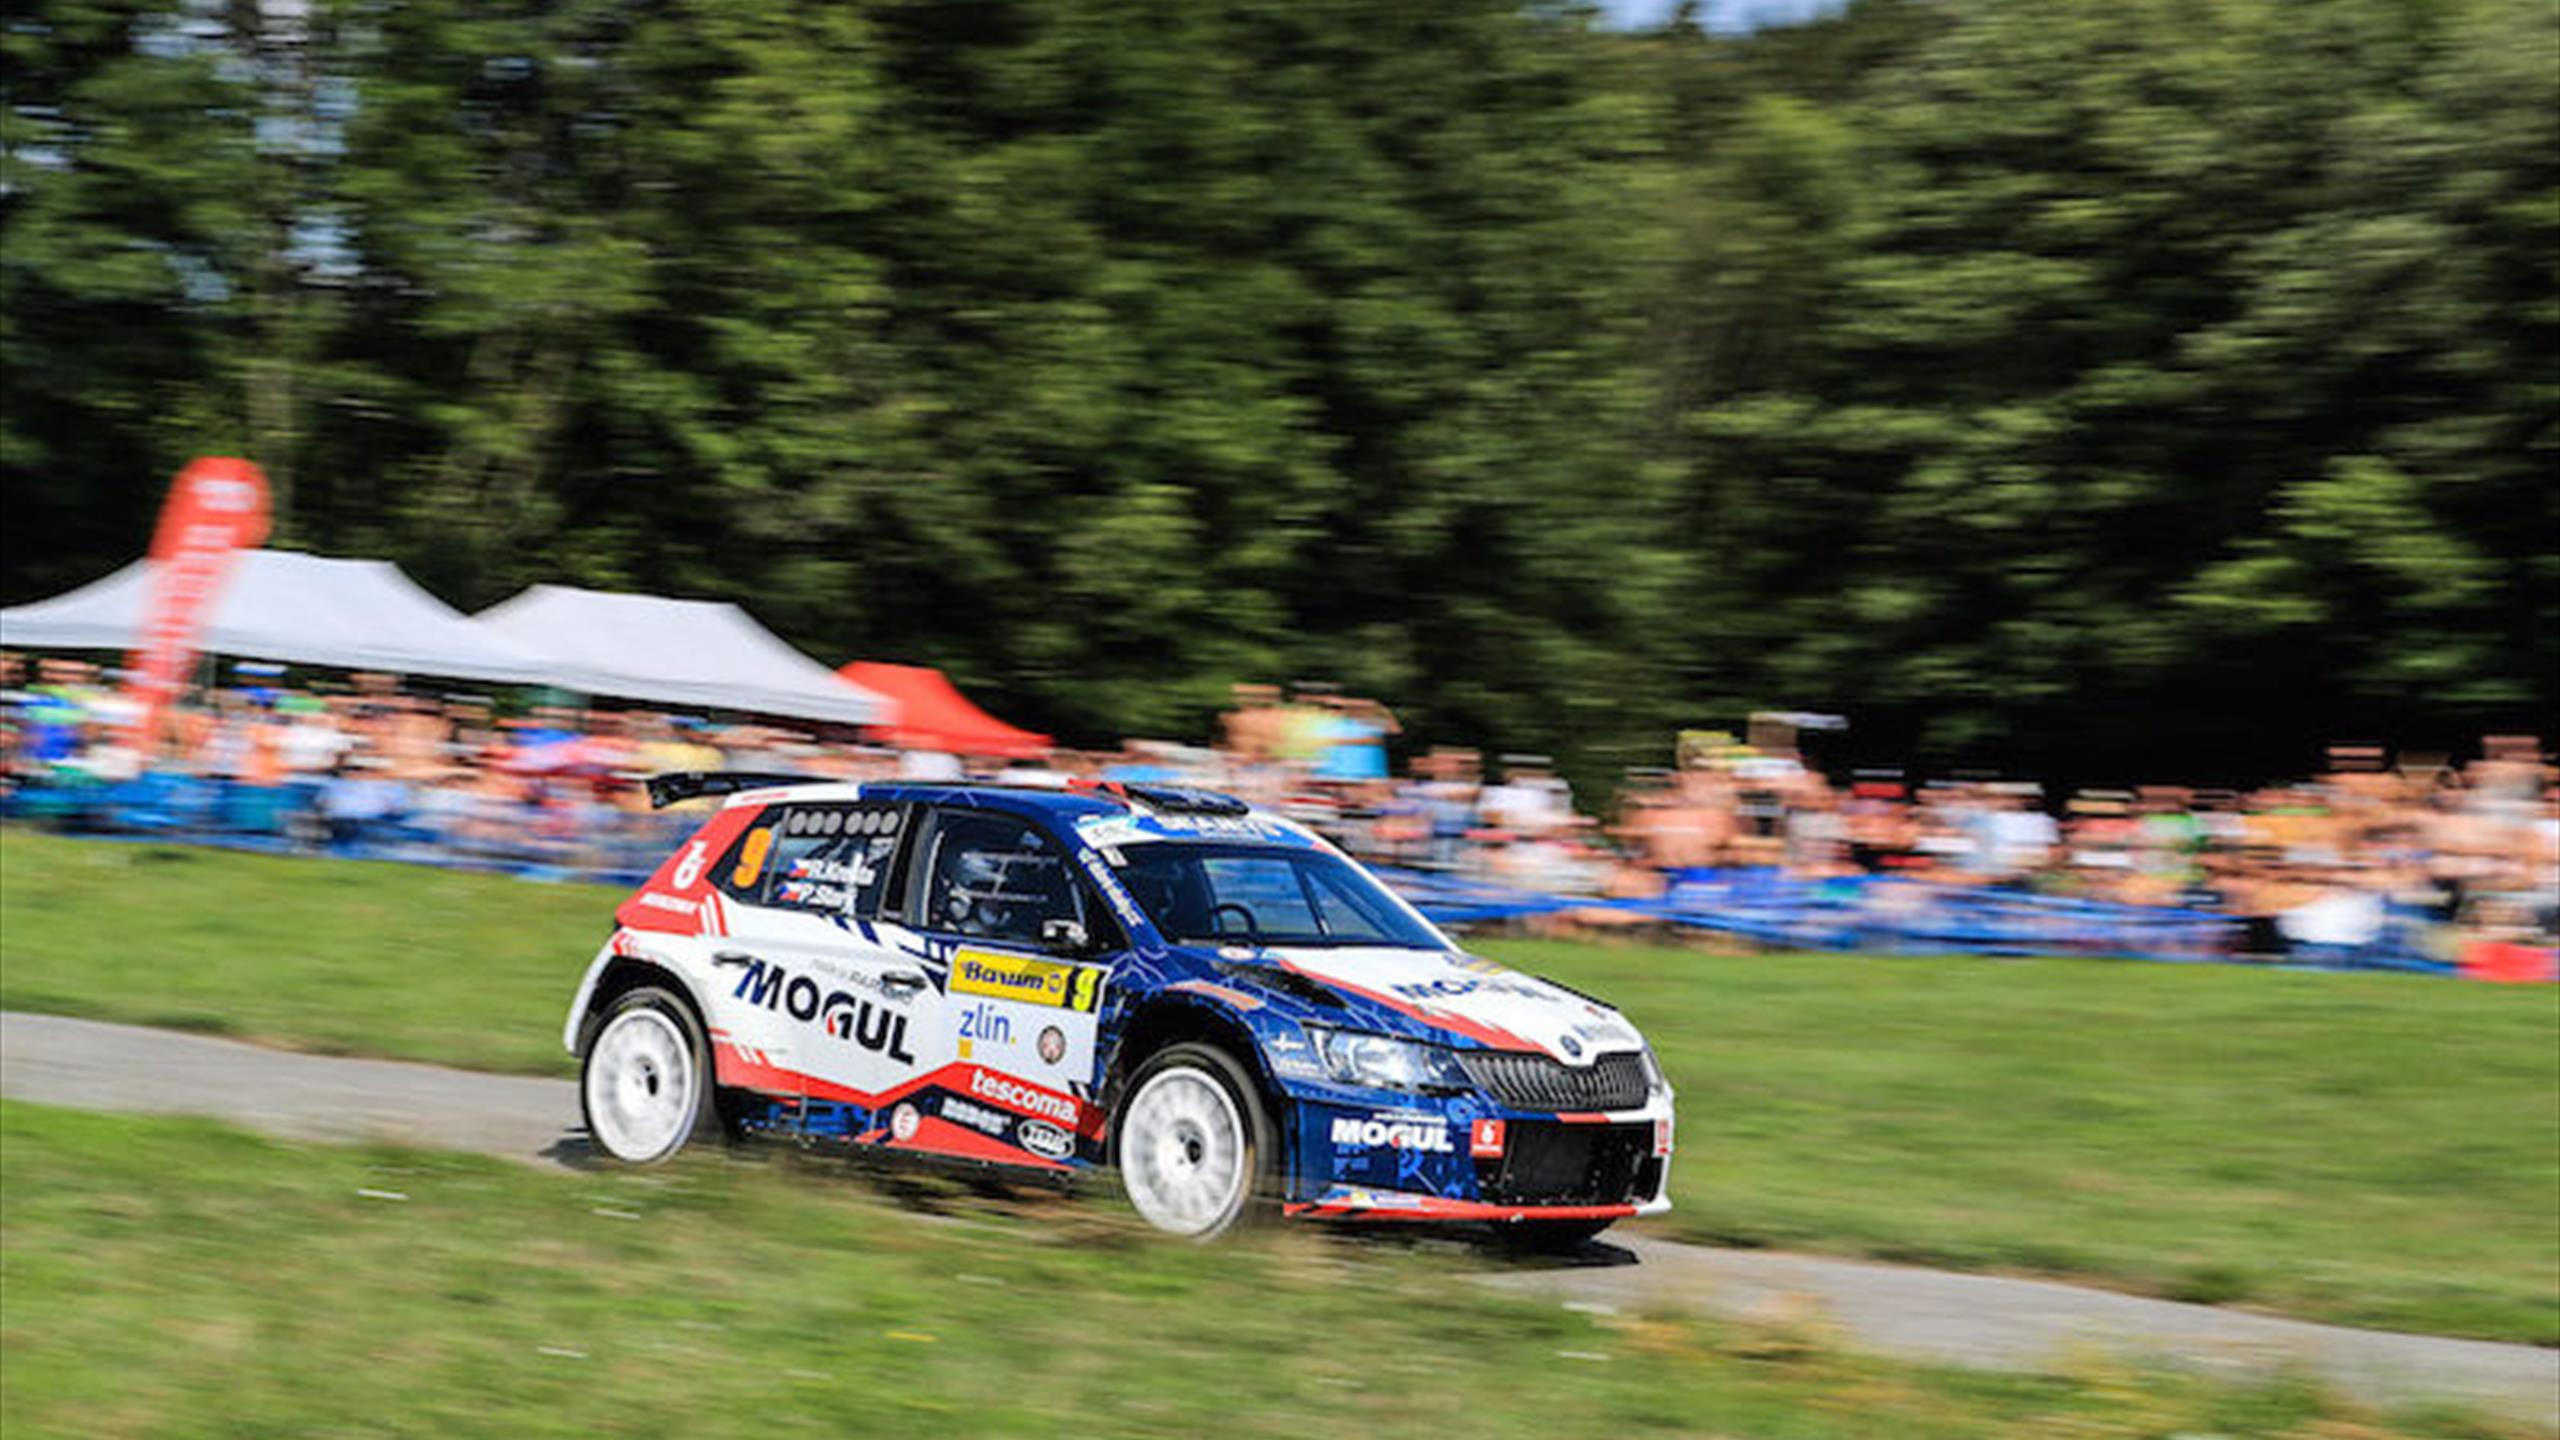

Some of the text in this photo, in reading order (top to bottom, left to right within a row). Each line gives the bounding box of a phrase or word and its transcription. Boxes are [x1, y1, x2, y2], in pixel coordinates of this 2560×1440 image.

[732, 827, 772, 889] 9
[963, 960, 1044, 990] Barum
[1072, 967, 1099, 1012] 9
[734, 957, 915, 1066] MOGUL
[1330, 1117, 1455, 1152] MOGUL
